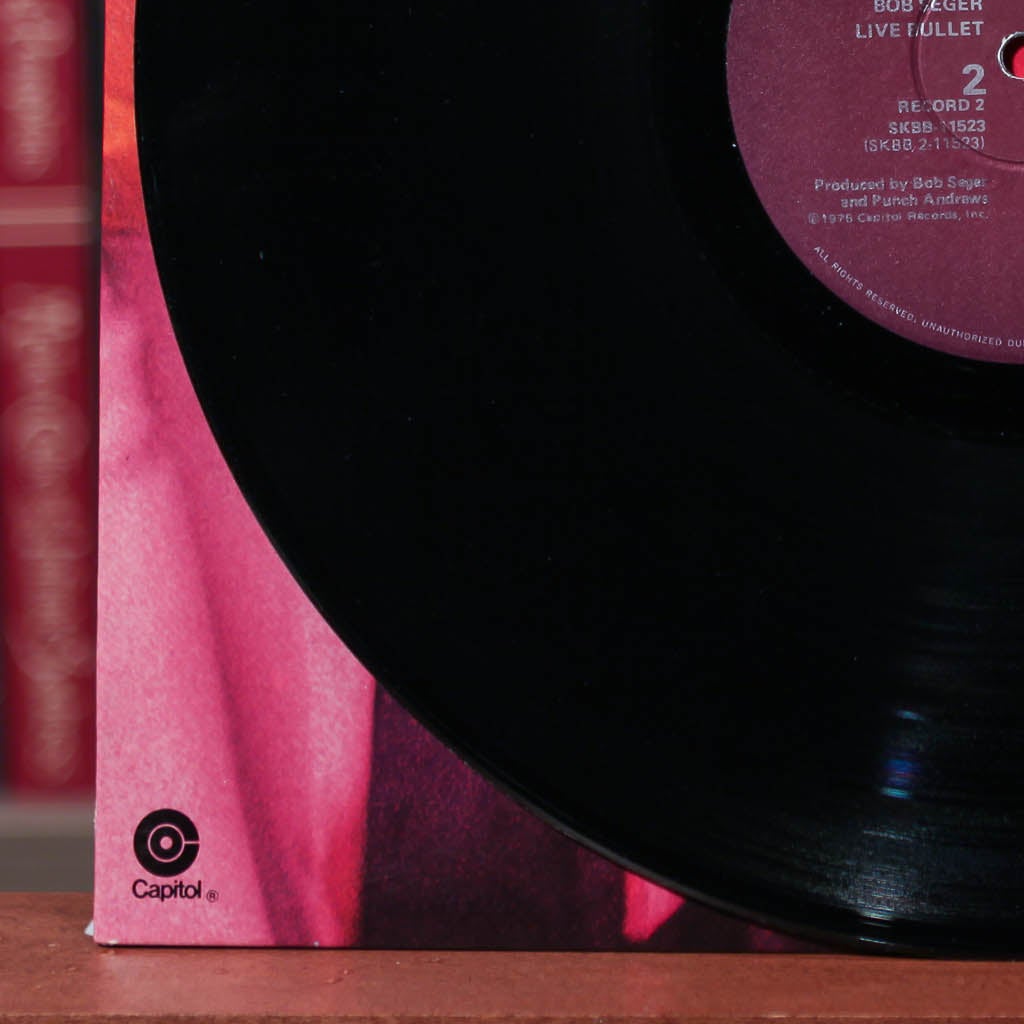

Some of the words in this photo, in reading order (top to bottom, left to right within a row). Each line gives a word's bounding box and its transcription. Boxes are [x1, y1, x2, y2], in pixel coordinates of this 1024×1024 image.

[855, 23, 901, 38] LIVE
[961, 63, 987, 96] 2
[975, 98, 985, 111] 2
[814, 178, 885, 191] Produced
[889, 177, 908, 192] by
[912, 176, 943, 190] Bob
[840, 194, 868, 208] and
[872, 193, 918, 207] Punch
[813, 245, 829, 264] ALL
[831, 262, 864, 291] RIGHTS
[921, 319, 1002, 347] UNAUTHORIZED
[132, 878, 202, 902] Capitol
